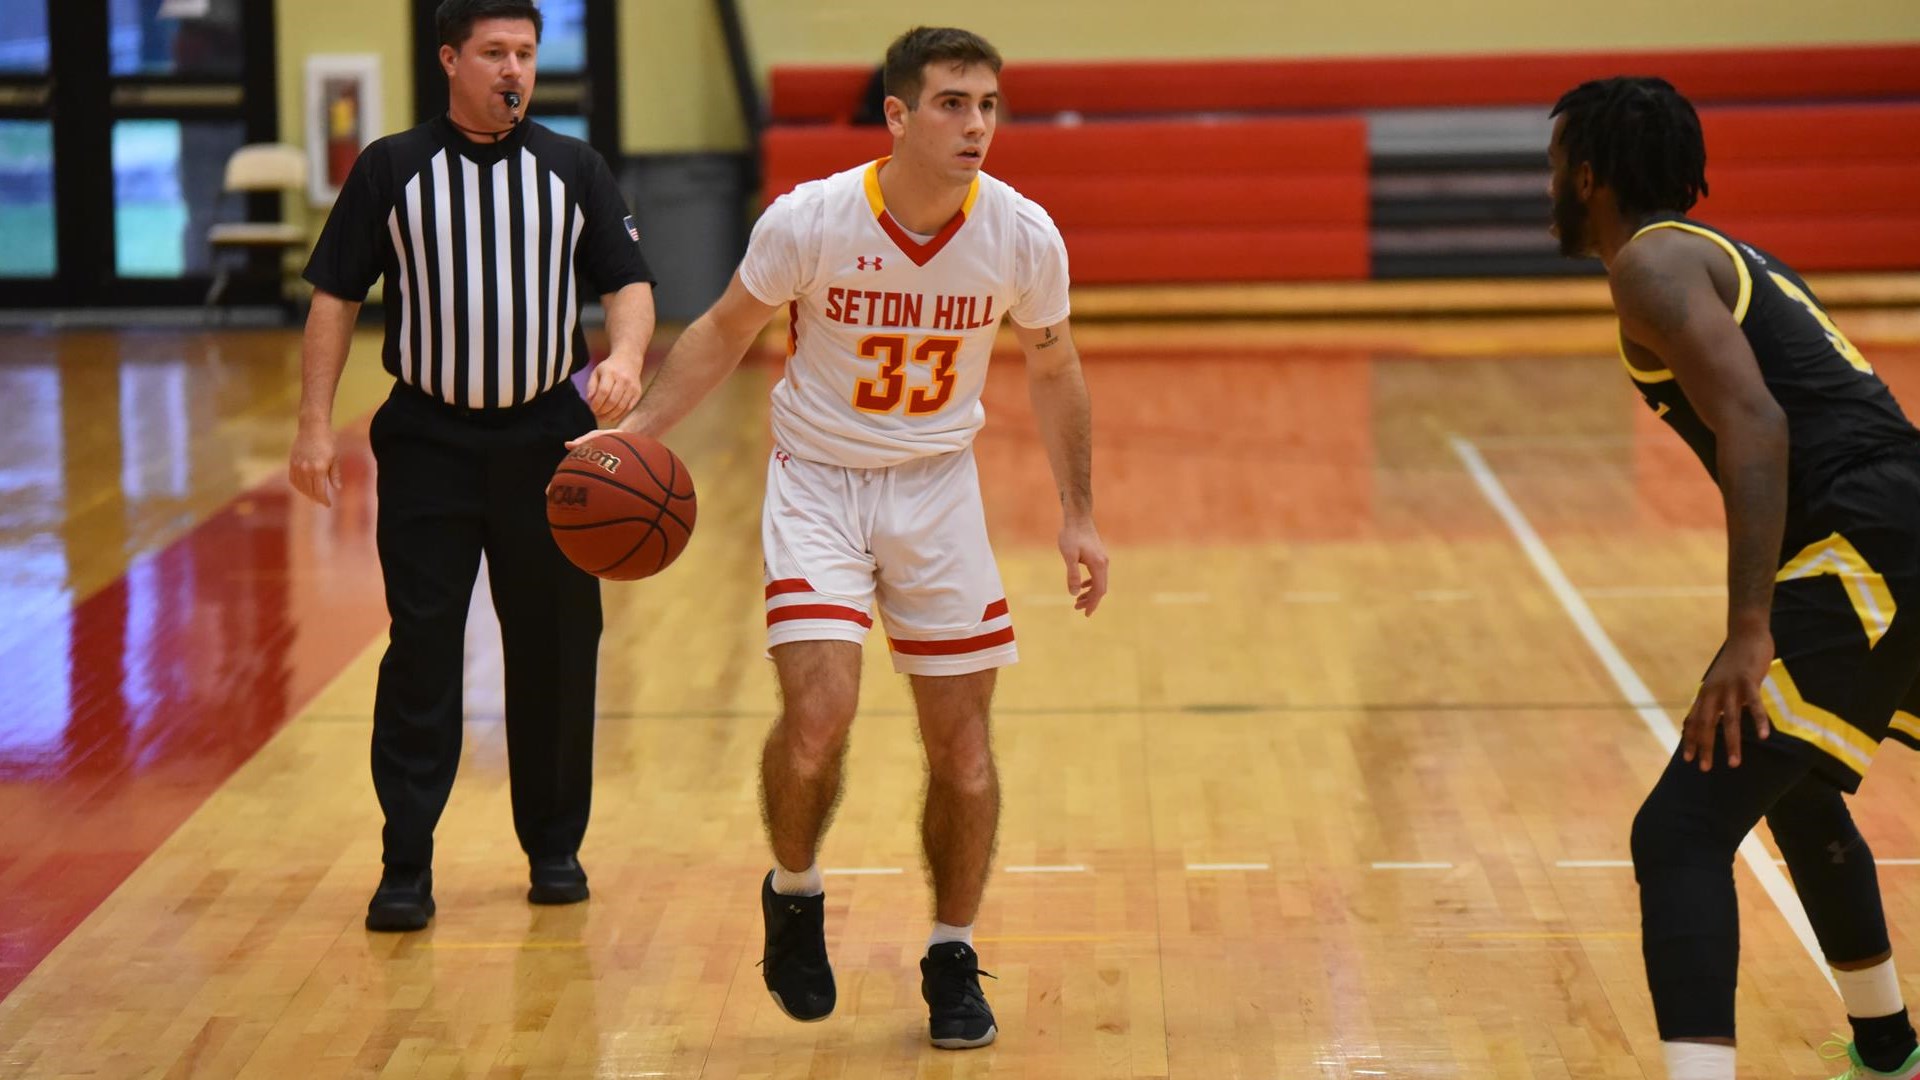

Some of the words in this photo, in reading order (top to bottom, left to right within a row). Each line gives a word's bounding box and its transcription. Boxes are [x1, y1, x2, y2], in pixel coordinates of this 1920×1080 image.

[826, 287, 923, 327] SETON
[933, 295, 994, 330] HILL
[853, 334, 963, 416] 33
